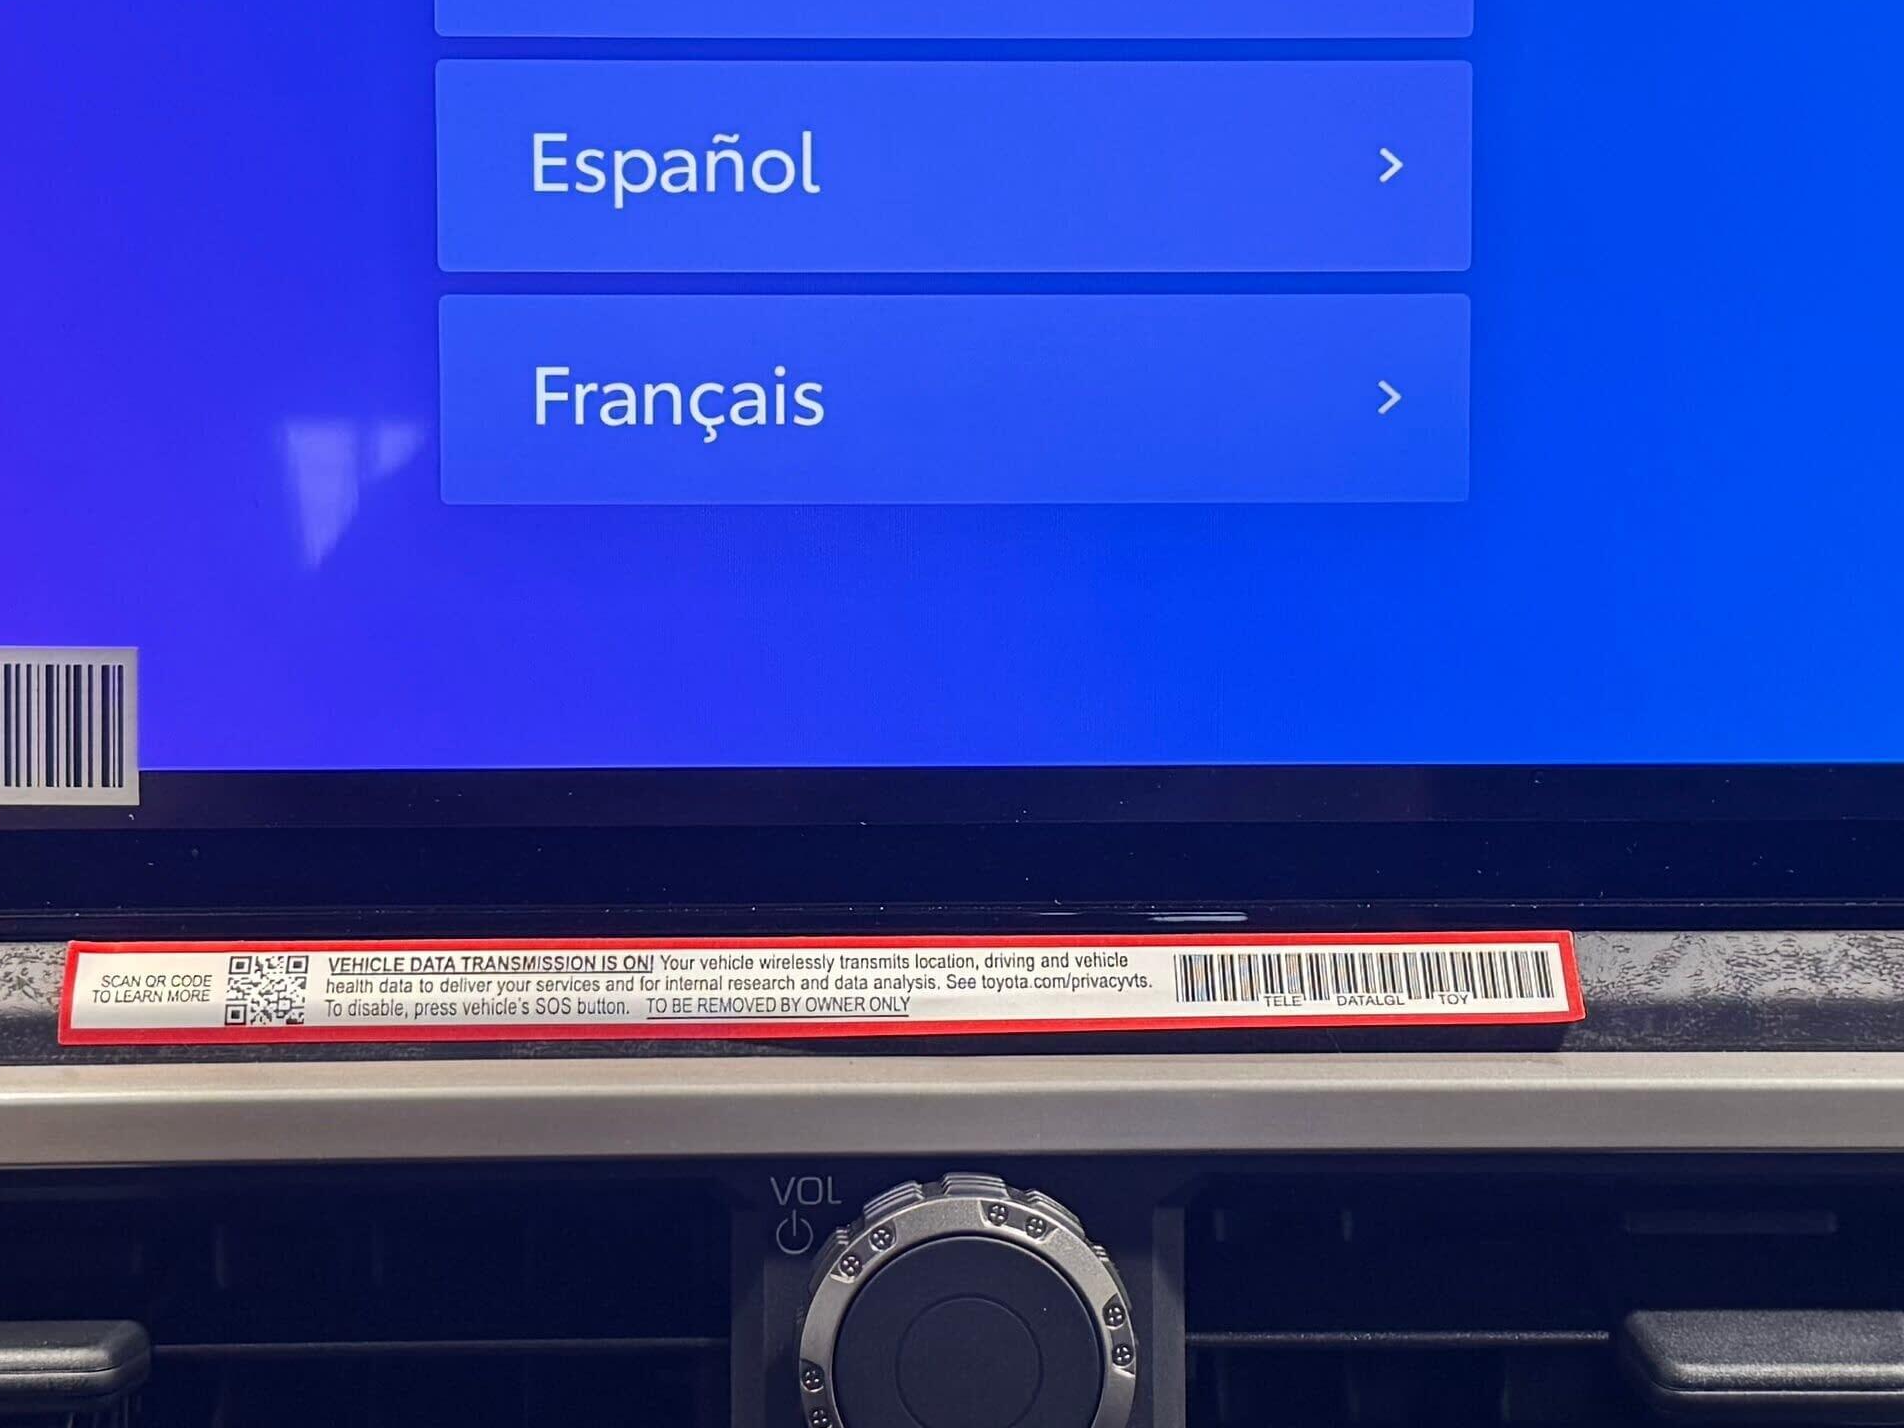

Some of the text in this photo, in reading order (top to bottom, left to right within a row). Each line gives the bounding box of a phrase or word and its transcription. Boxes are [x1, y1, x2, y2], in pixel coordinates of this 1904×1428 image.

[529, 129, 822, 210] Español
[531, 364, 827, 445] Français
[328, 951, 1129, 973] VEHICLE DATA TRANSMISSION IS ON! Your vehicle wirelessly transmits location, driving and vehicle
[100, 974, 212, 988] SCAN QR CODE
[325, 971, 1153, 997] health data to deliver your services and for internal research and data analysis. See toyota.com/privacyvts.
[92, 988, 210, 1003] TO LEARN MORE
[324, 995, 911, 1020] To disable, press vehicle's SOS button. TO BE REMOVED BY OWNER ONLY
[1263, 992, 1470, 1008] TELE DATALGL TOY
[768, 1175, 843, 1207] VOL
